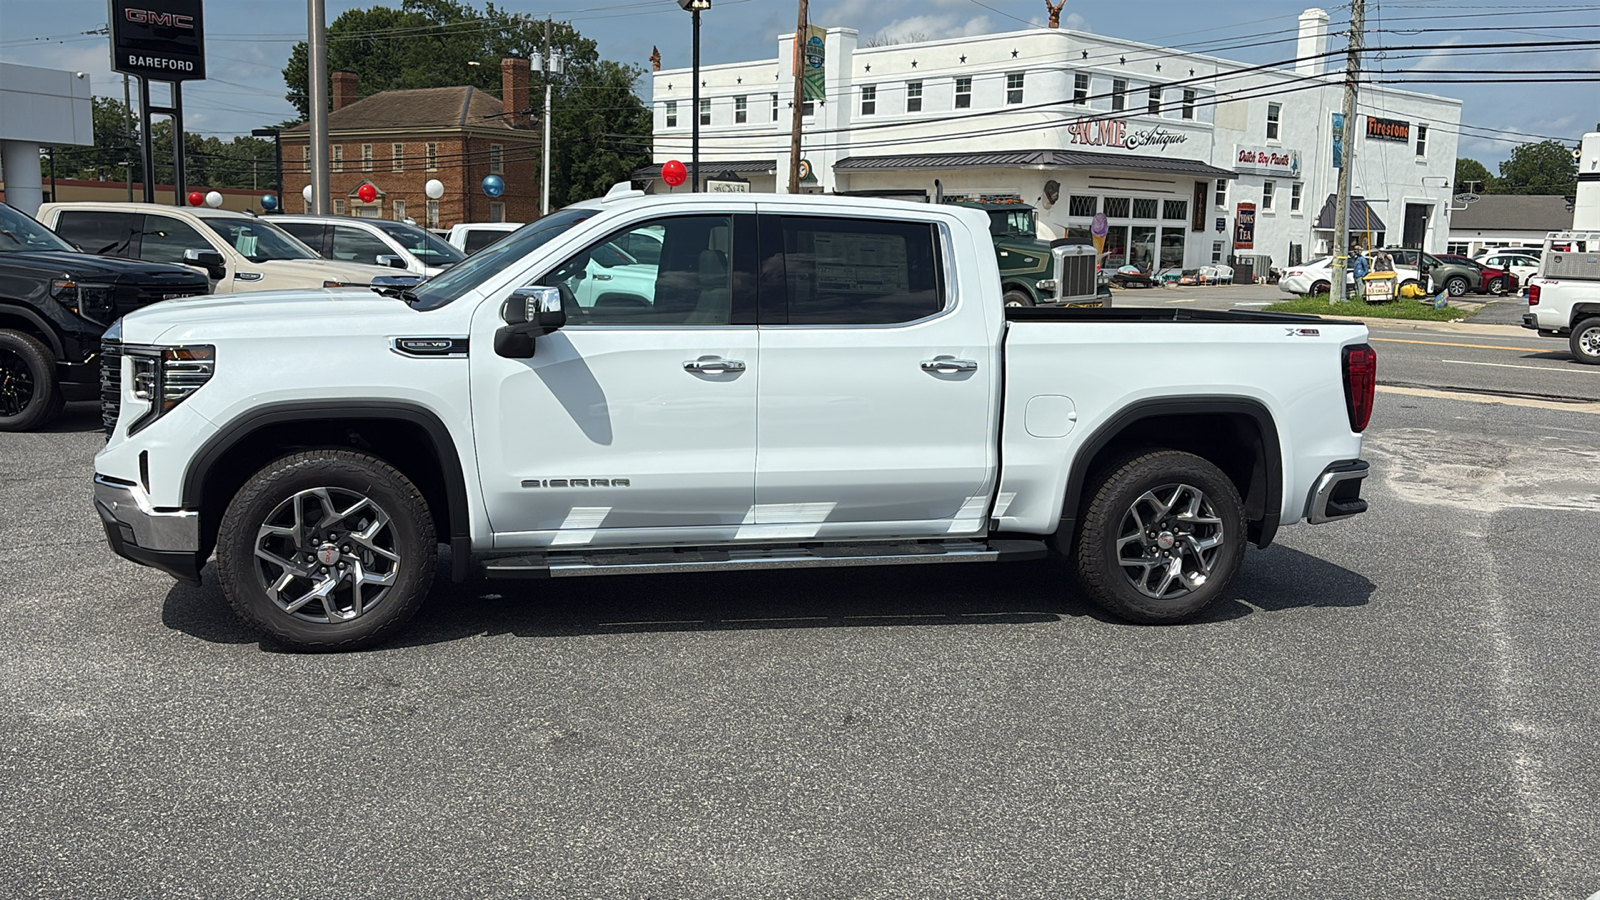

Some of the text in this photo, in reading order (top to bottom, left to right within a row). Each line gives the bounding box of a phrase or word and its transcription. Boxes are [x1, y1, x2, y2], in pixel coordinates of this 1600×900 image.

[125, 8, 194, 29] GMC
[128, 55, 194, 72] BAREFORD
[1068, 116, 1127, 148] ACME
[1138, 124, 1188, 151] Antiques
[1367, 116, 1409, 138] Firestone
[1238, 149, 1290, 167] Dutch Boy Paints
[1239, 228, 1251, 240] TEA
[521, 478, 630, 488] SIERRA
